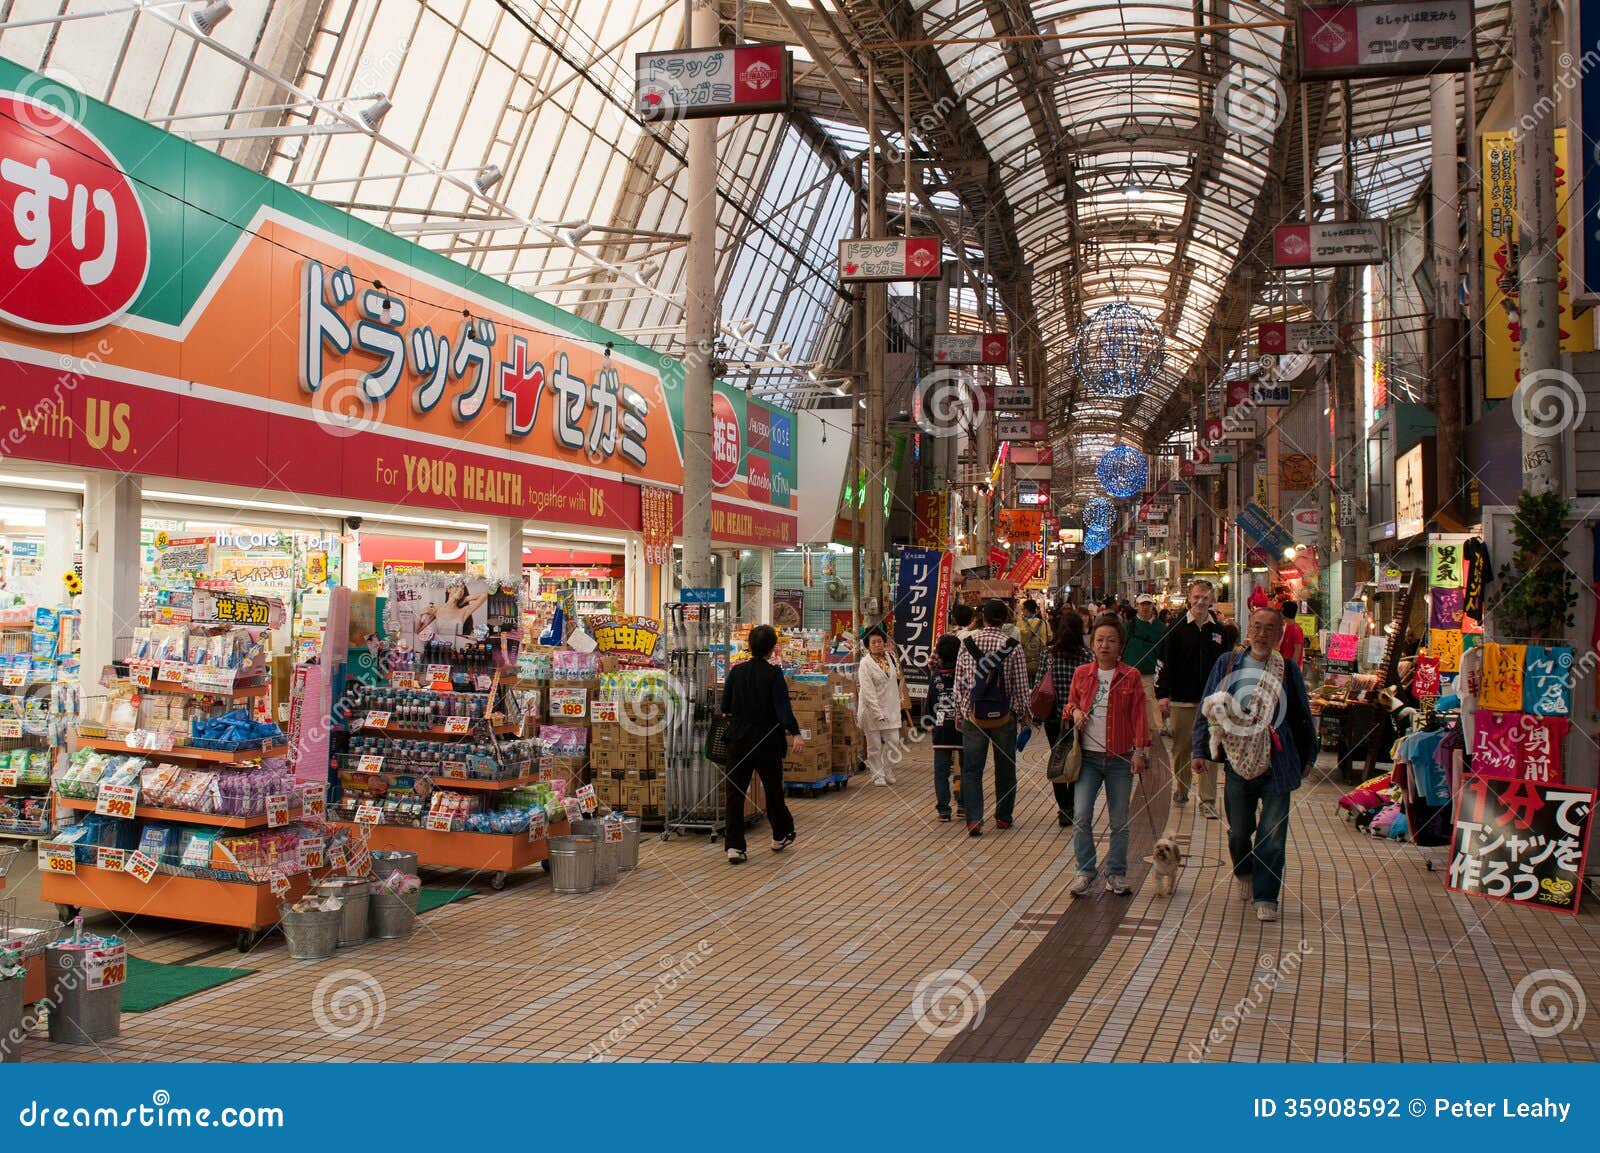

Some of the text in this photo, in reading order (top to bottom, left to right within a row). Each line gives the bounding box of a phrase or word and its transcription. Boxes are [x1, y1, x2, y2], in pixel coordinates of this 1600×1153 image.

[649, 53, 724, 81] ドラッグ
[669, 82, 733, 105] セガミ
[0, 157, 118, 286] すり
[847, 242, 899, 258] ドラッグ
[862, 260, 904, 274] セガミ
[301, 260, 497, 422] ドラッグ
[16, 400, 73, 438] with
[547, 351, 648, 468] セガミ
[713, 416, 738, 464] 粧品
[376, 457, 399, 486] For
[403, 455, 458, 497] YOUR
[528, 484, 567, 512] together
[569, 489, 587, 511] with
[711, 509, 725, 534] OUR
[1437, 545, 1458, 581] 男気
[217, 599, 270, 624] 世界初
[906, 564, 929, 642] リアップ
[594, 625, 658, 656] 殺虫剤
[896, 644, 930, 668] X5
[562, 703, 582, 715] 198
[600, 711, 617, 722] 98
[1523, 726, 1552, 783] 男前
[107, 799, 132, 816] 398
[1469, 780, 1592, 836] 1分で
[1456, 821, 1582, 872] Tシャツを
[51, 858, 73, 871] 398
[105, 859, 121, 869] 599
[132, 863, 149, 879] 599
[1450, 852, 1540, 900] 作ろう
